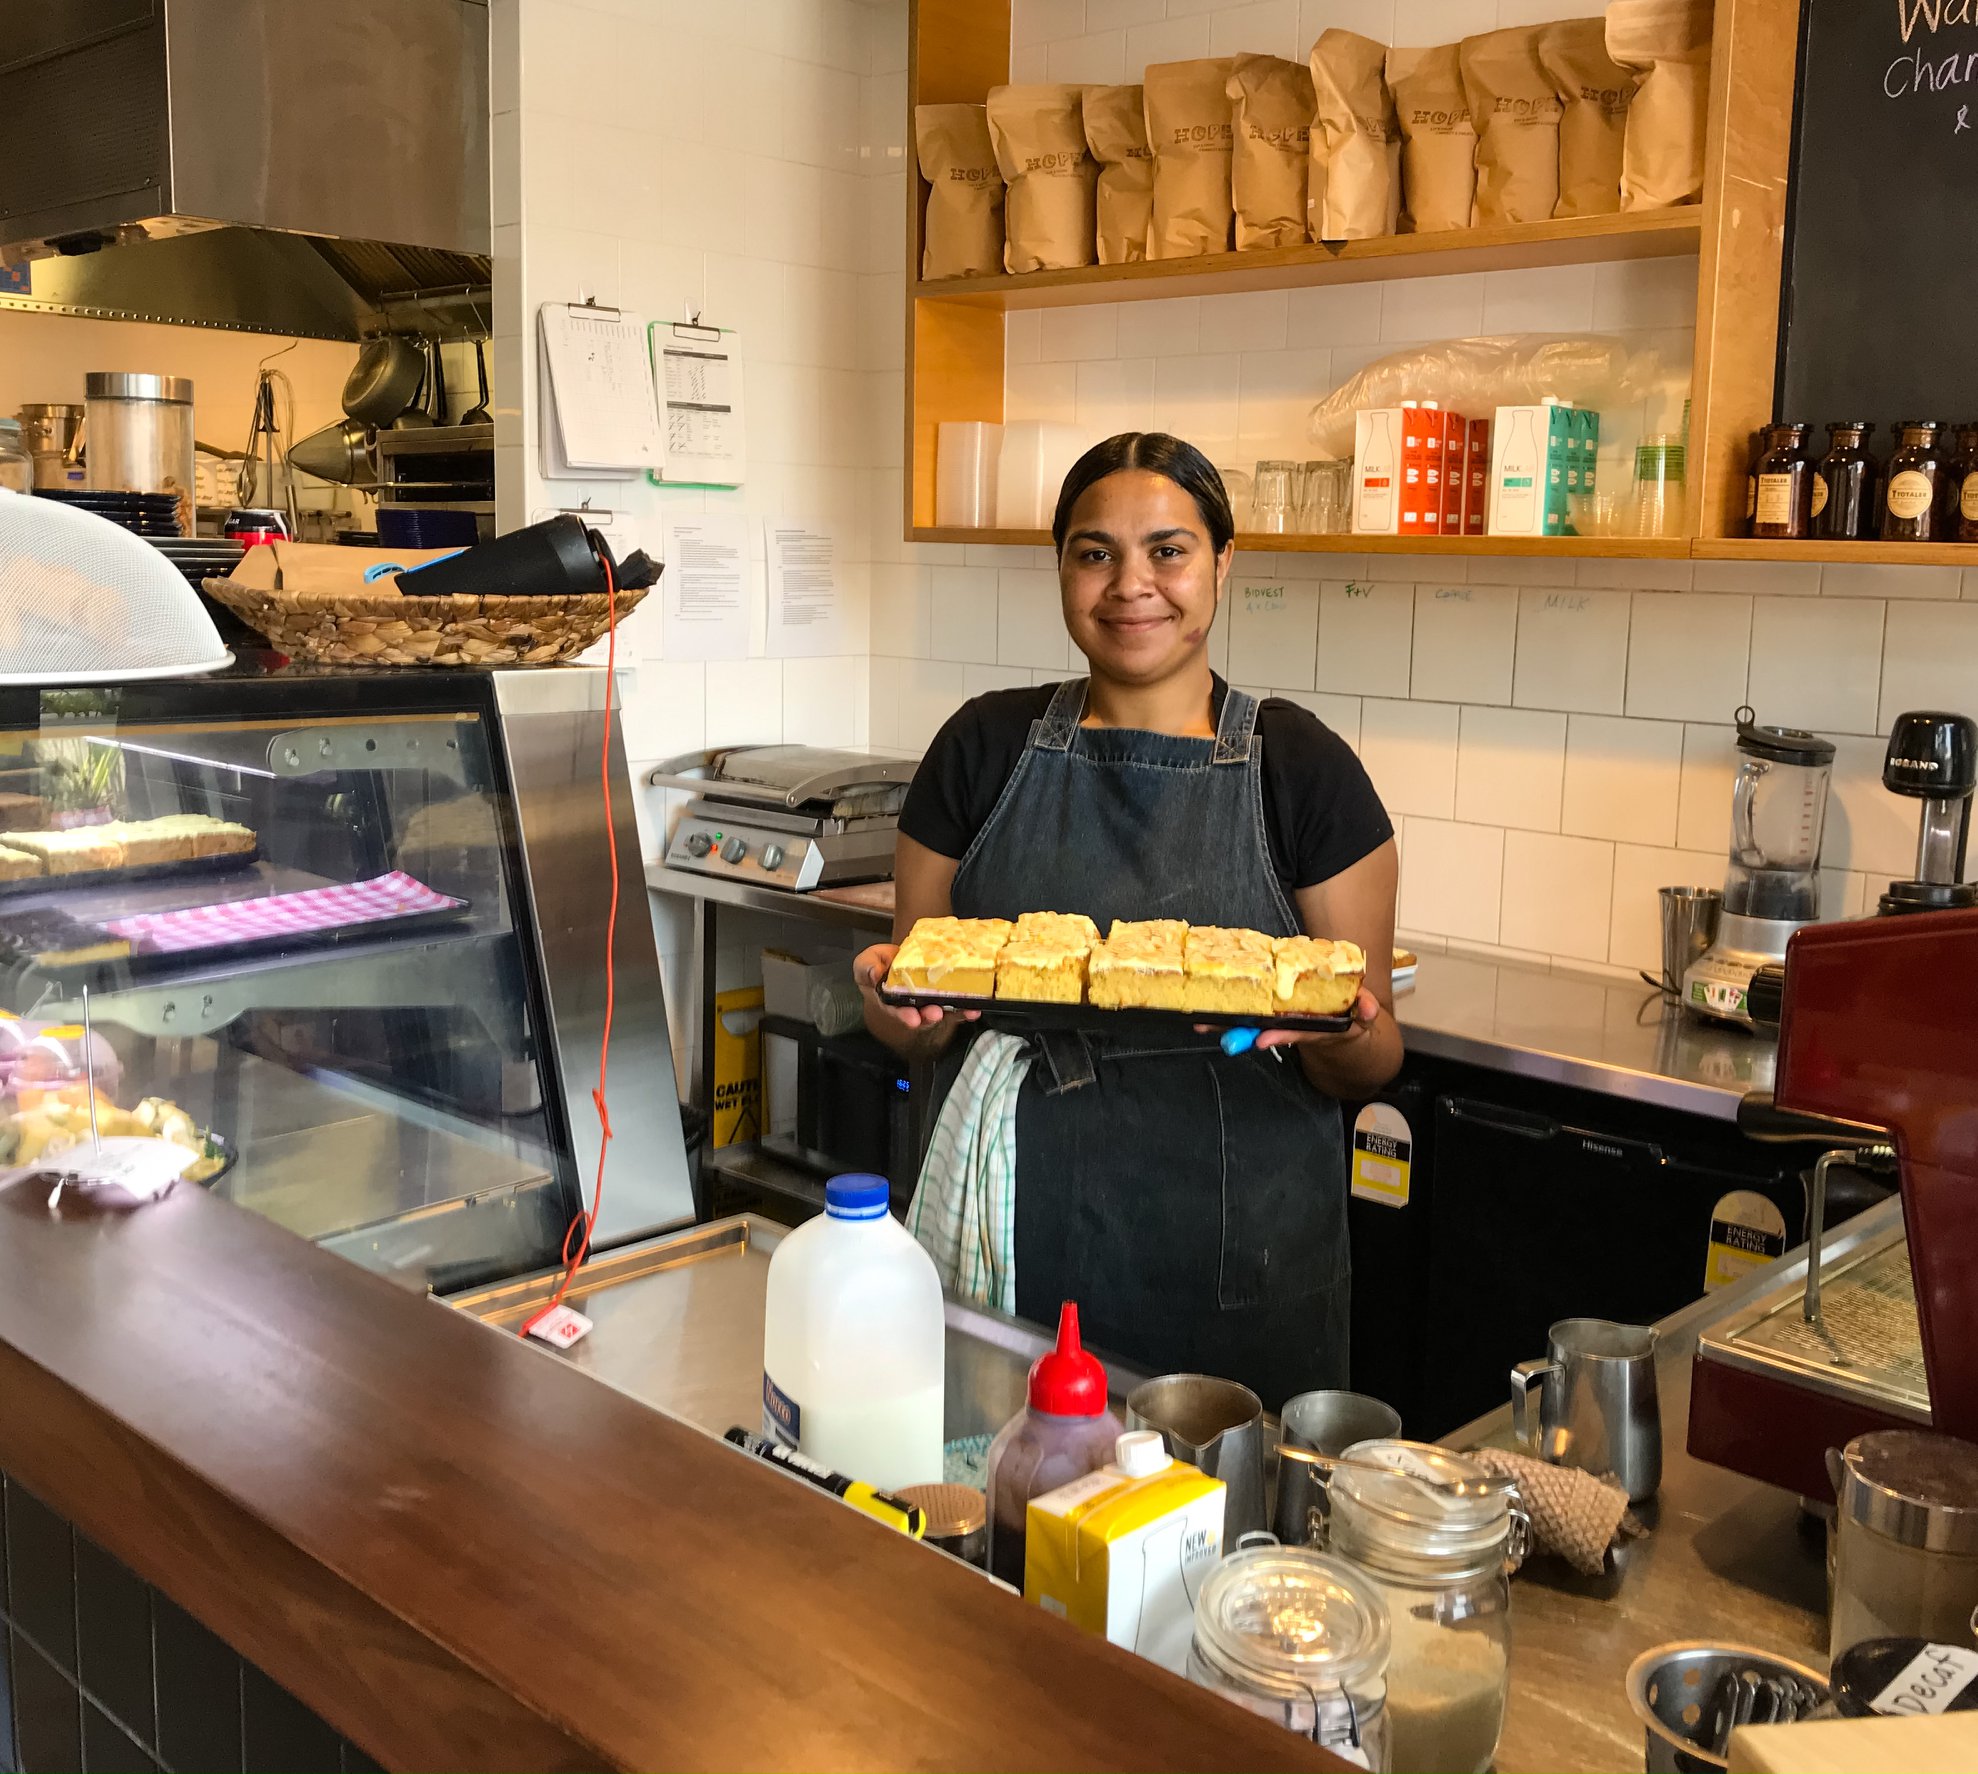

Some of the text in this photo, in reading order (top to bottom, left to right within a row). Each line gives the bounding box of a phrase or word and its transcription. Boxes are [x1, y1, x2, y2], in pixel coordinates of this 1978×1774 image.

[1898, 0, 1978, 43] Wa
[1244, 586, 1285, 598] BIDVEST
[1365, 1142, 1397, 1160] RATING
[1366, 1133, 1398, 1150] ENERGY
[1727, 1224, 1767, 1243] ENERGY
[1726, 1234, 1766, 1255] RATING
[1185, 1528, 1207, 1552] NEW
